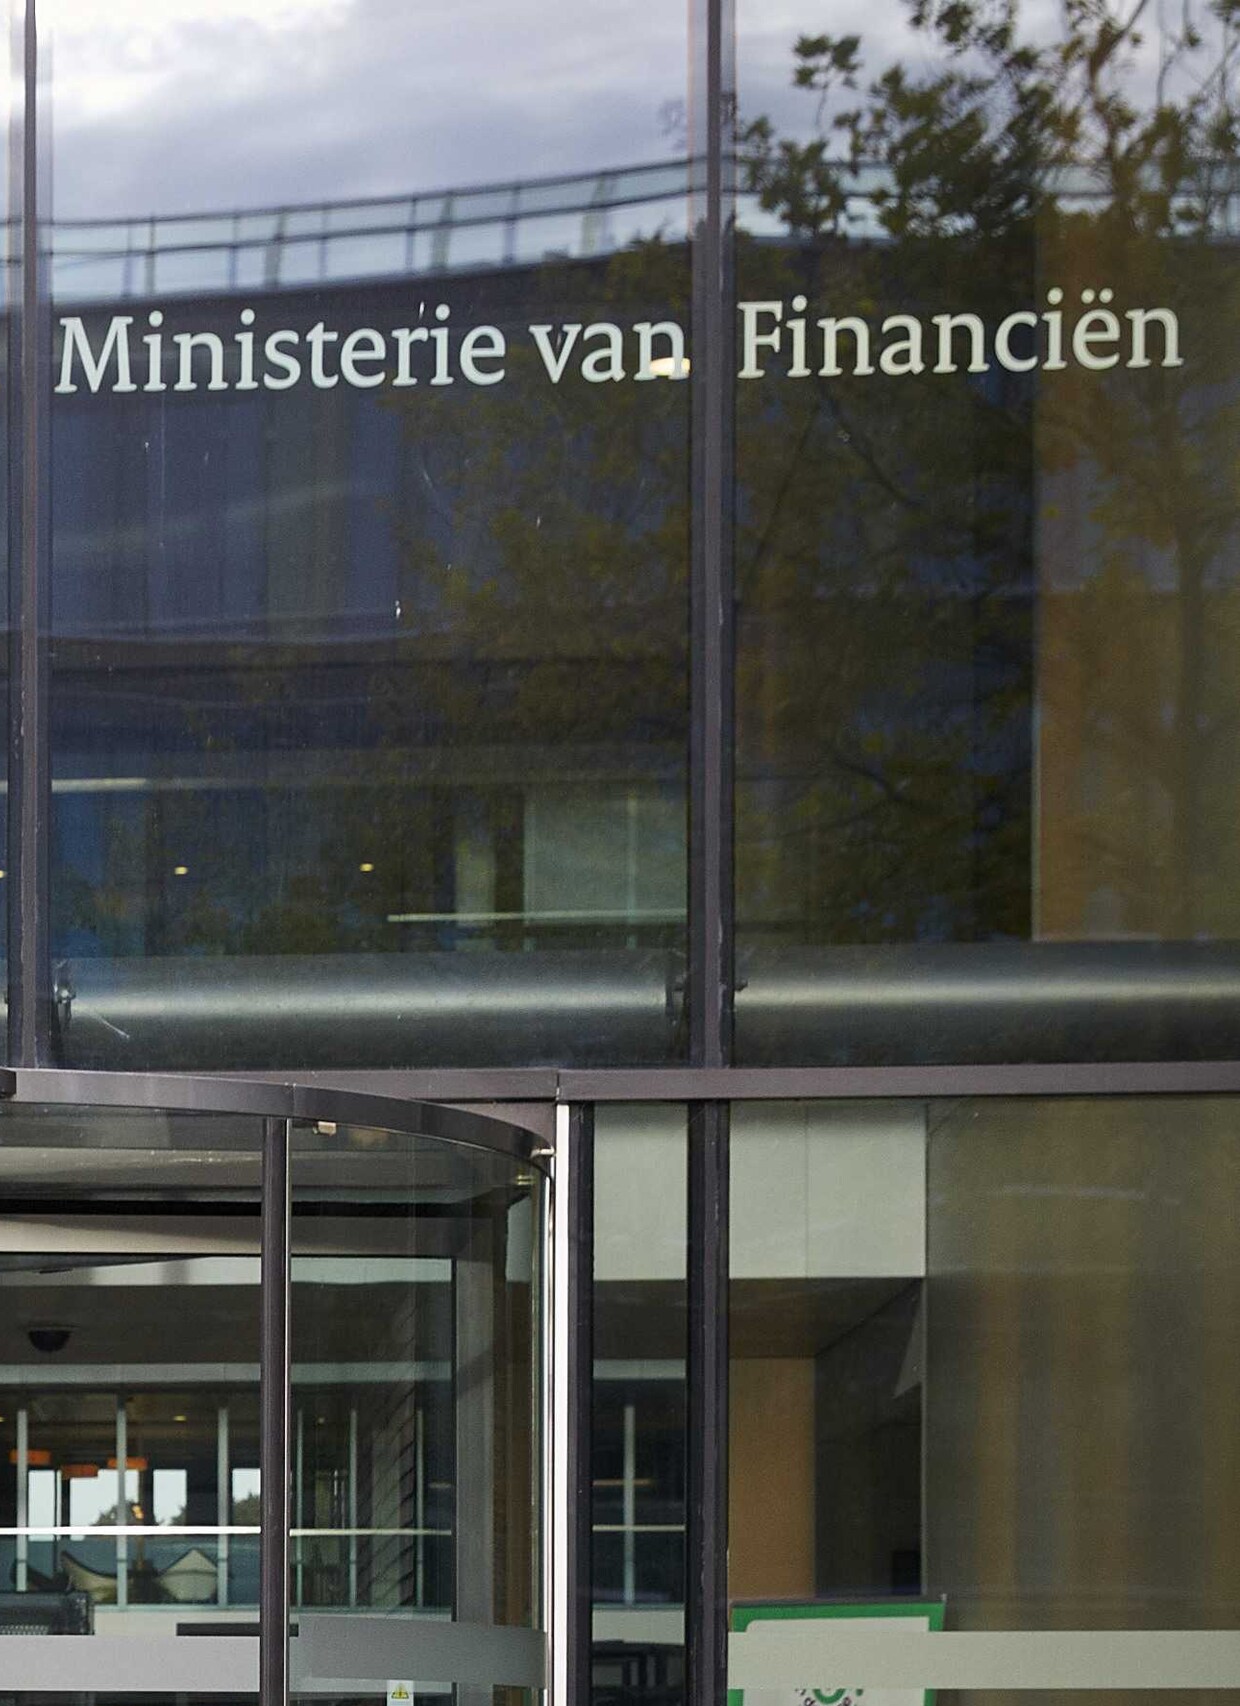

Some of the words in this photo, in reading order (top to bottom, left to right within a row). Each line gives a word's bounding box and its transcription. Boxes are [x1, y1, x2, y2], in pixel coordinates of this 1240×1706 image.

[54, 303, 506, 394] Ministerie
[529, 320, 689, 383] van
[737, 286, 1185, 379] Financiën
